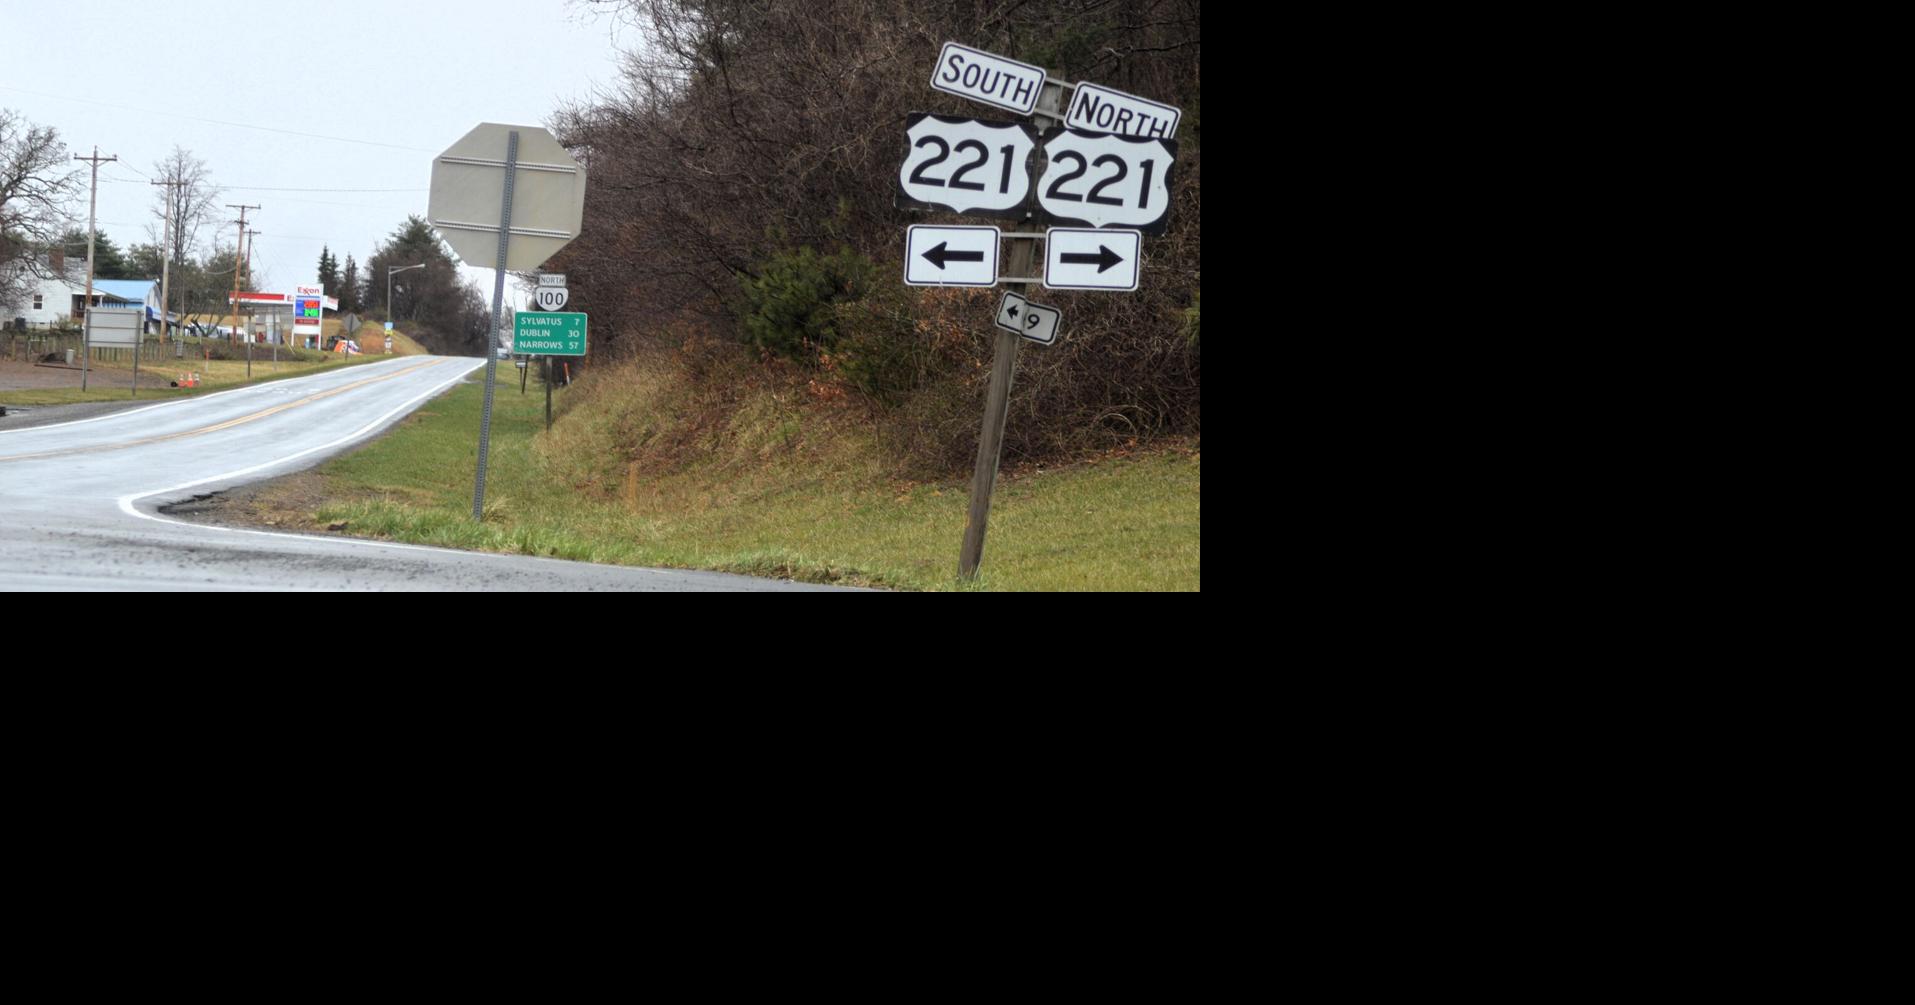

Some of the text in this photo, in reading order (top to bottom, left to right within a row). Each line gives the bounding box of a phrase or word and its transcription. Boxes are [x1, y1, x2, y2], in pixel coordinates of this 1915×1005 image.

[942, 54, 1034, 105] SOUTH
[1074, 92, 1169, 139] NORTH
[909, 135, 1014, 194] 221
[1045, 150, 1154, 209] 221
[541, 276, 565, 284] NORTH
[297, 287, 320, 295] Exxon
[539, 292, 564, 305] 100
[521, 317, 580, 326] SYLVATUS 7
[1027, 313, 1040, 329] 9
[520, 329, 580, 338] DUBLIN 30
[519, 341, 579, 350] NARROWS 57
